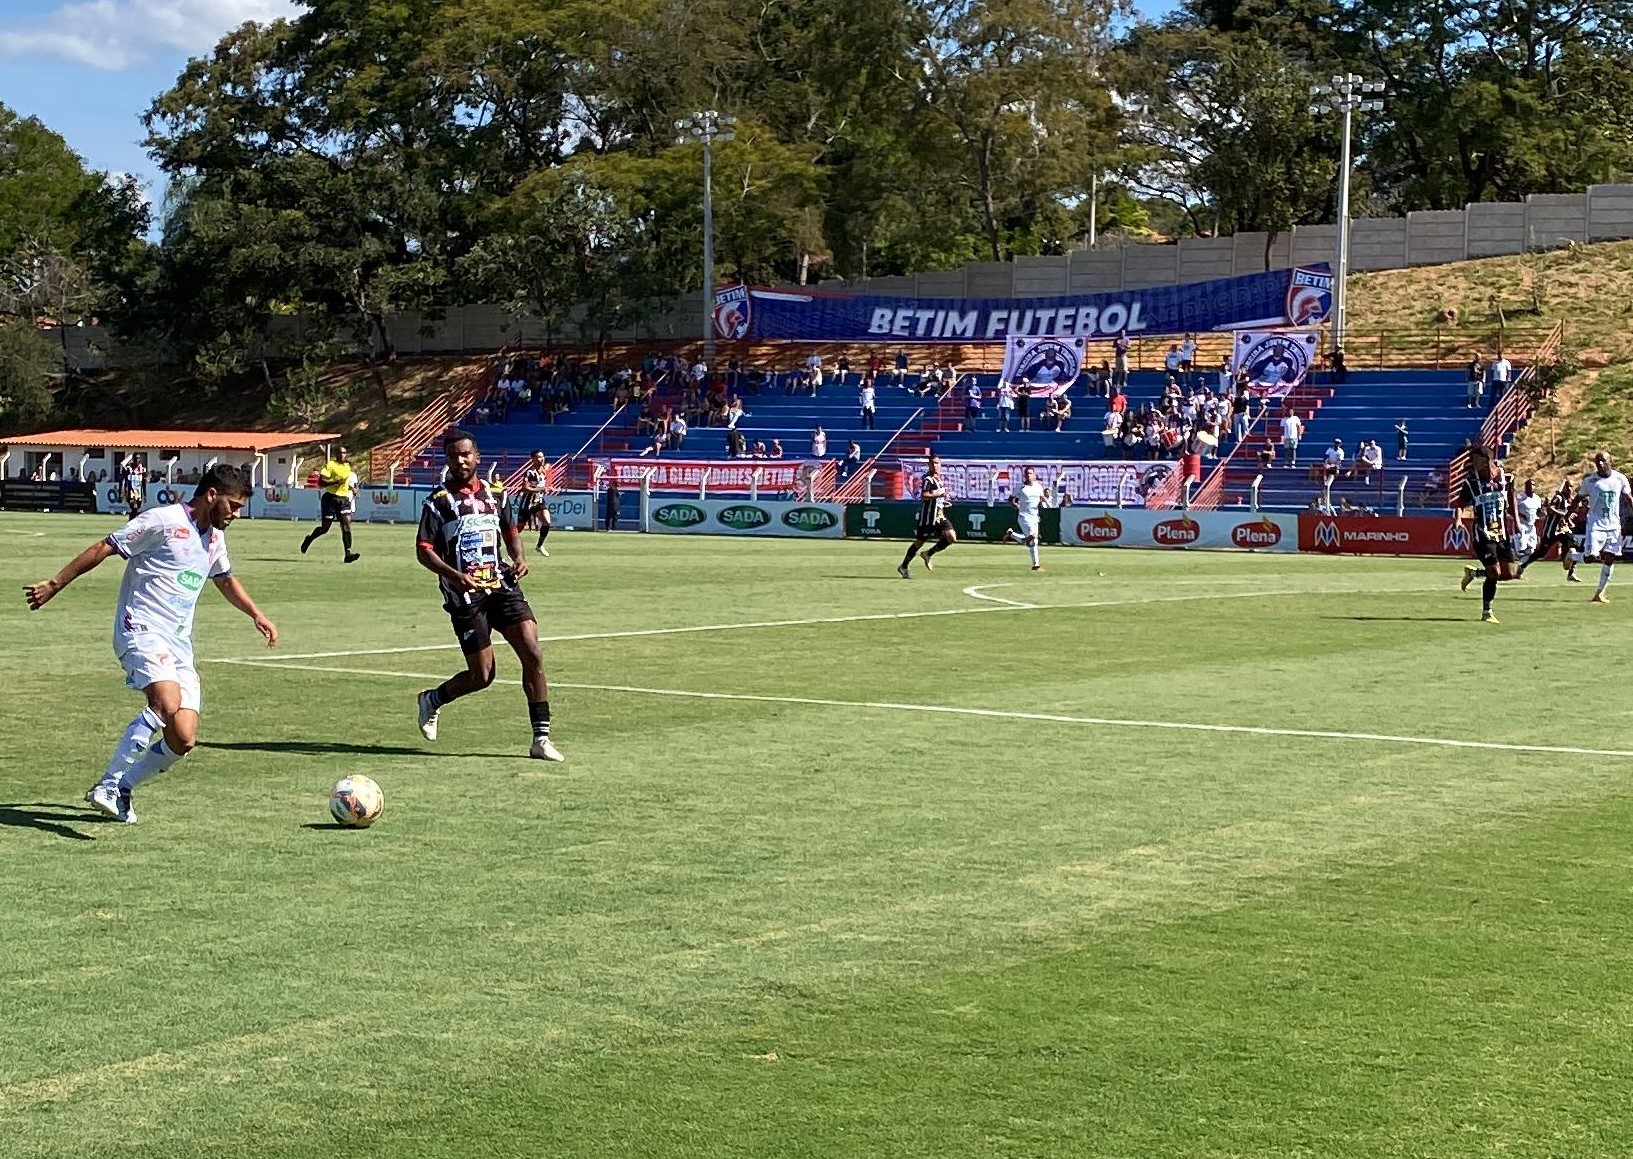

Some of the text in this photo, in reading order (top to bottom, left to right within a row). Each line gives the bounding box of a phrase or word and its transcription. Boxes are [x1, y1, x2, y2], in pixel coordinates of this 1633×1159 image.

[868, 308, 978, 338] BETIM
[985, 303, 1147, 338] FUTEBOL
[658, 508, 700, 522] SADA
[722, 510, 765, 523] SADA
[788, 511, 831, 525] SADA
[1080, 523, 1118, 537] Plena
[1157, 525, 1195, 540] Plena
[1236, 528, 1276, 542] Plena
[1343, 532, 1409, 541] MARINHO
